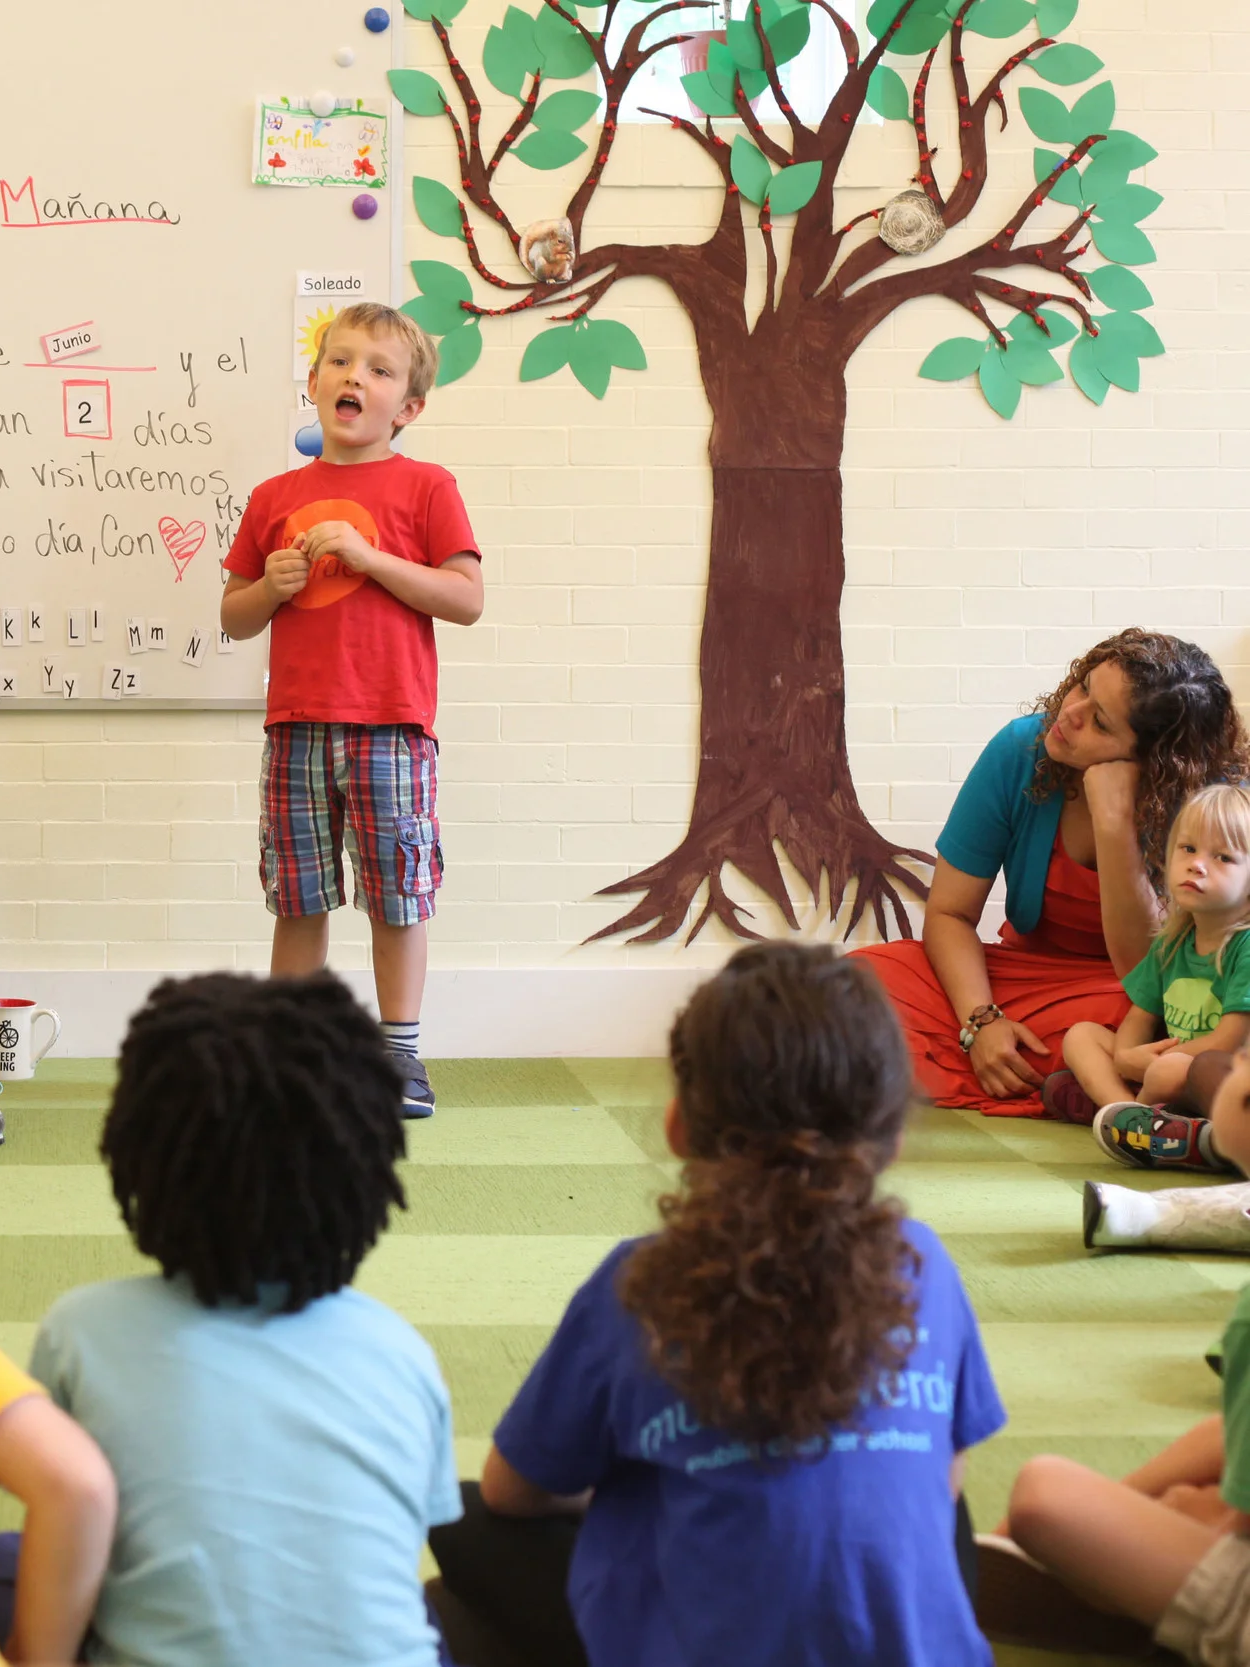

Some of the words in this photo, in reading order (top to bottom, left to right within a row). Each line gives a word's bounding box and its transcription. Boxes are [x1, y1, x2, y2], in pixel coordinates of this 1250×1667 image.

[0, 176, 180, 225] Mañana
[304, 276, 361, 291] Soleado
[53, 332, 91, 353] Junio
[180, 351, 200, 408] y
[218, 337, 247, 374] el
[78, 402, 92, 424] 2
[134, 410, 212, 446] días
[32, 451, 229, 496] visitaremos
